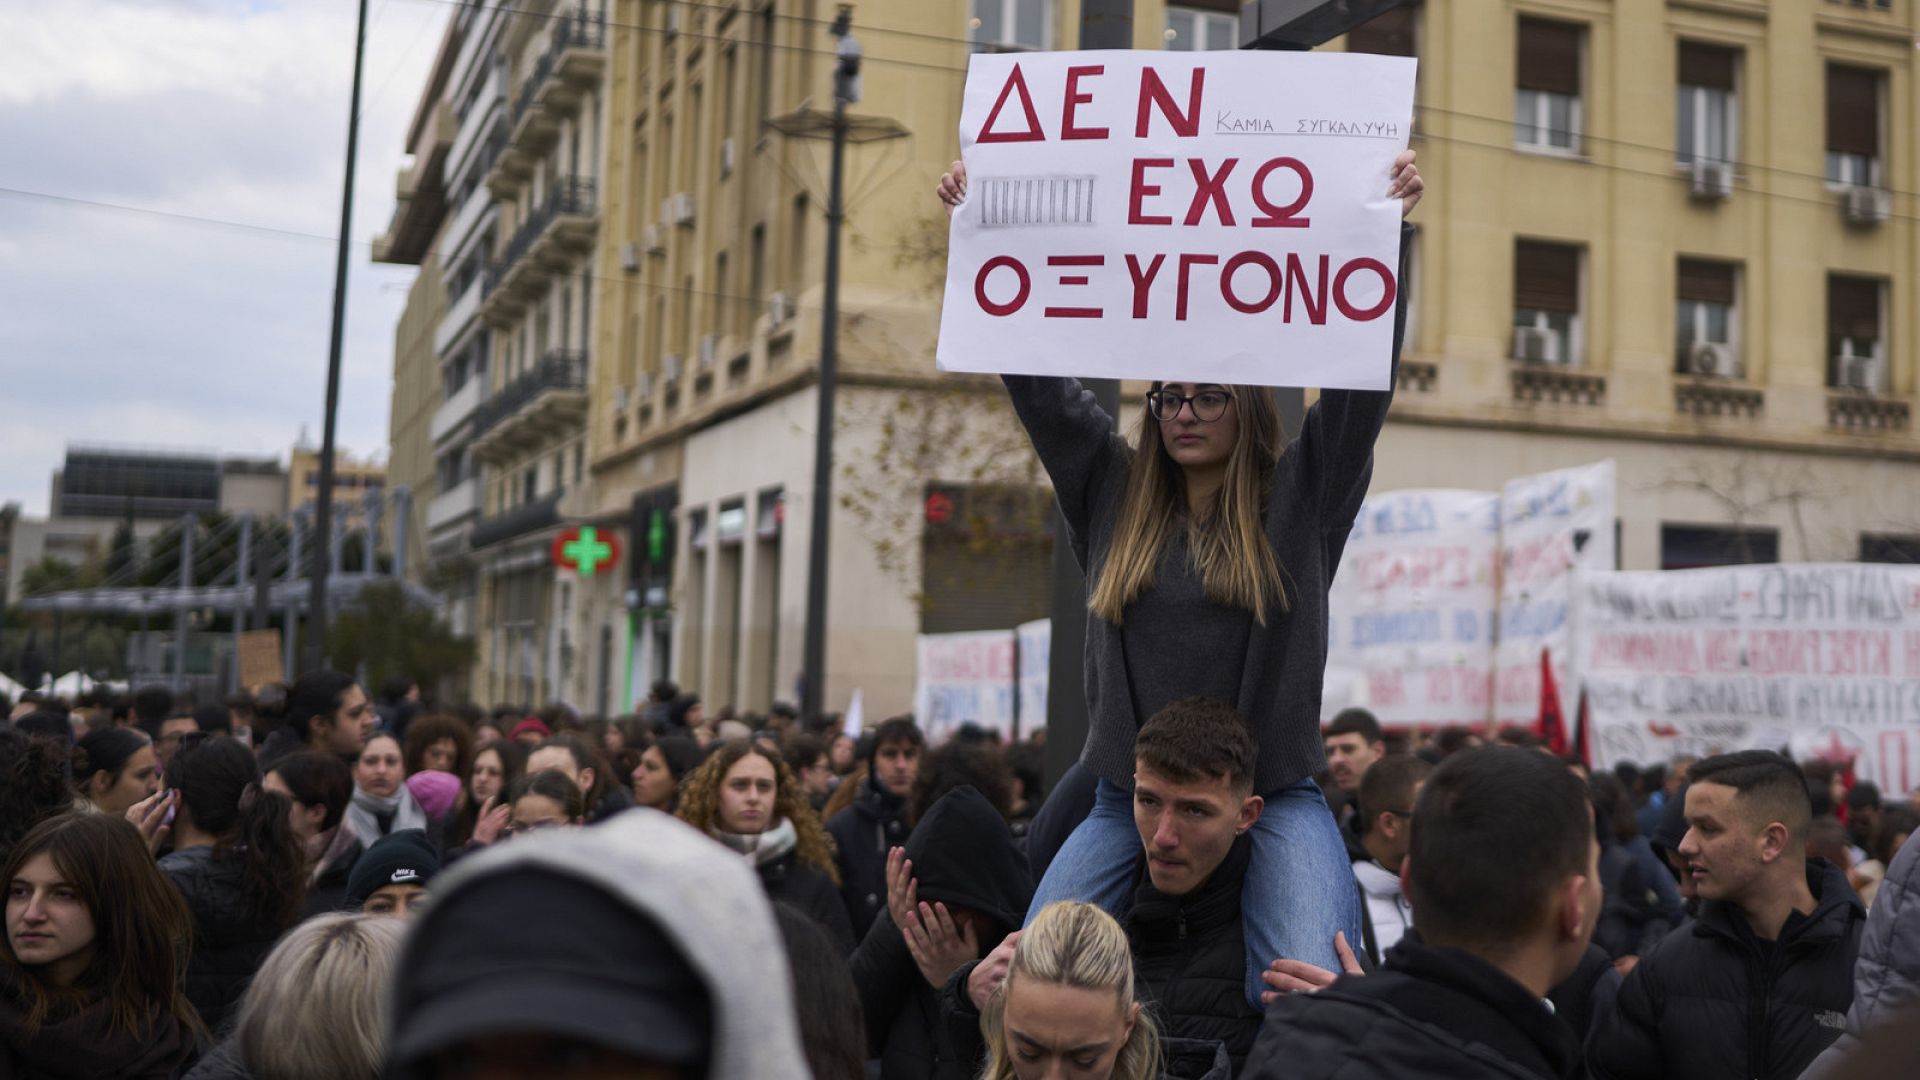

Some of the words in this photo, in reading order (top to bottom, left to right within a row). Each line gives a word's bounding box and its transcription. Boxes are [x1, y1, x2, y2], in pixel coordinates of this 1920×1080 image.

[975, 62, 1206, 144] ΔΕΝ
[1216, 110, 1274, 132] ΚΑΜΙΑ
[1296, 118, 1398, 137] ΣΥΓΚΑΛΥΨΗ
[1127, 156, 1314, 228] ΕΧΩ
[974, 250, 1397, 325] ΟΞΥΓΟΝΟ
